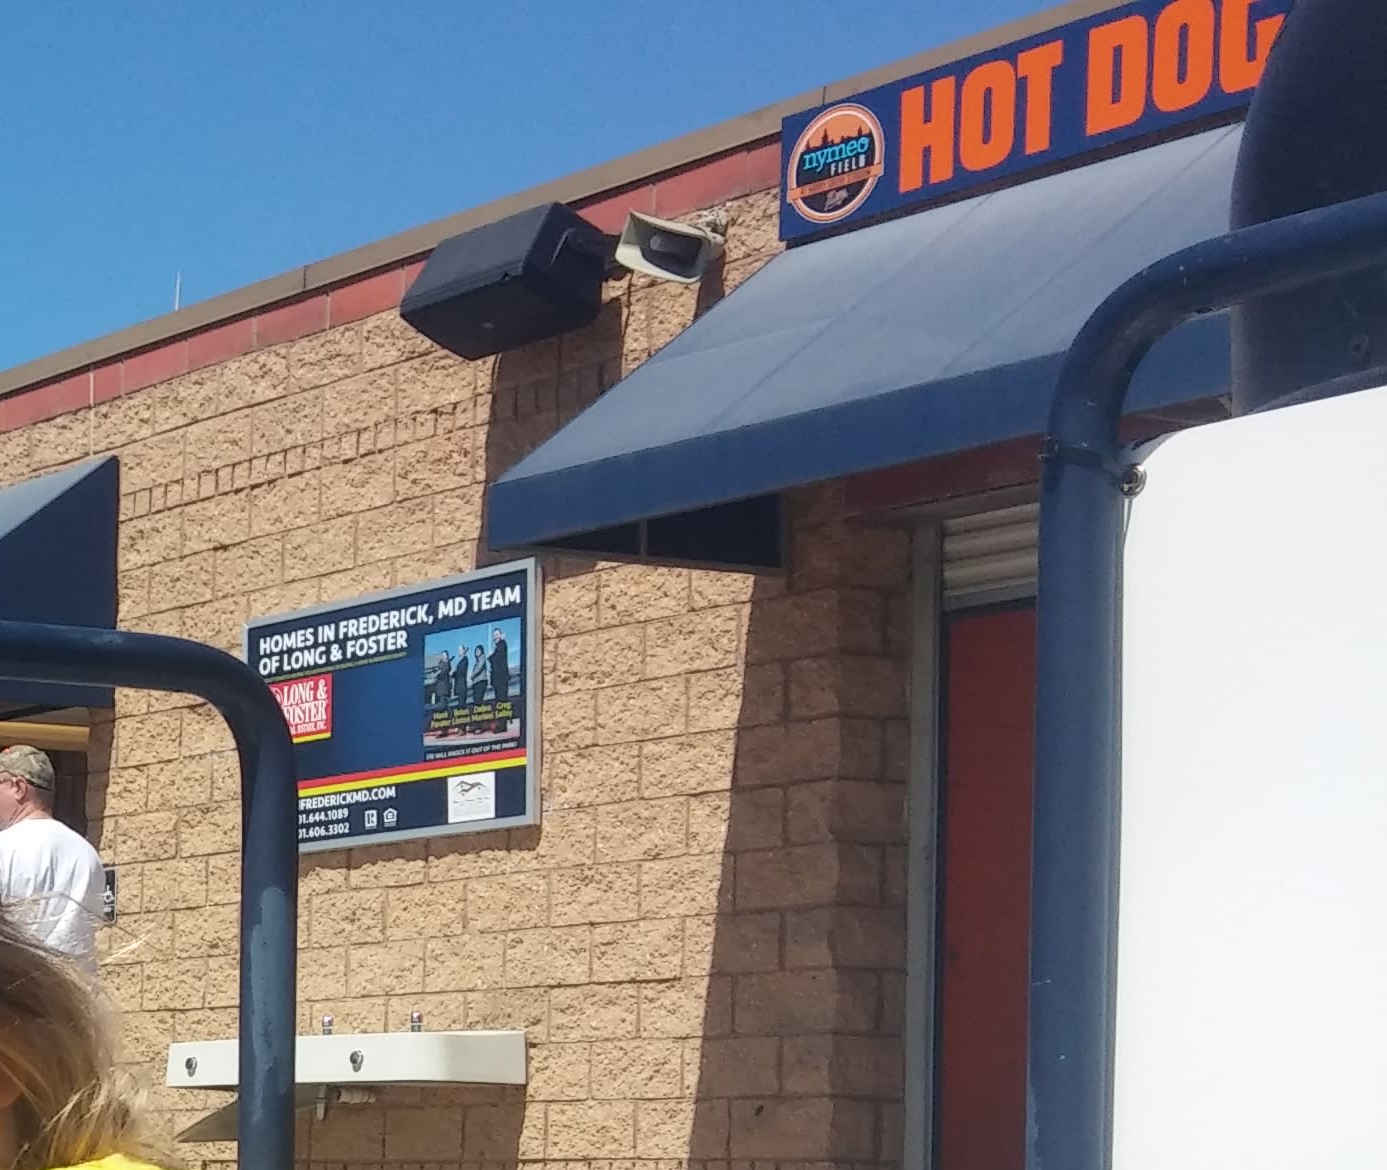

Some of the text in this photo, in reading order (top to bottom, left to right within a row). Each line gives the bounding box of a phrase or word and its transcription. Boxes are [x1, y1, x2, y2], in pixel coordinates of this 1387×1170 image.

[898, 39, 1064, 194] HOT
[802, 136, 871, 173] nymeo
[829, 154, 866, 177] FIELD
[259, 584, 522, 656] HOMES IN FREDERICK, MD TEAM
[258, 655, 280, 676] OF
[282, 645, 327, 672] LONG
[329, 643, 343, 662] &
[345, 630, 409, 660] FOSTER
[283, 678, 328, 706] LONG &
[299, 785, 396, 811] FREDERICKMD.COM
